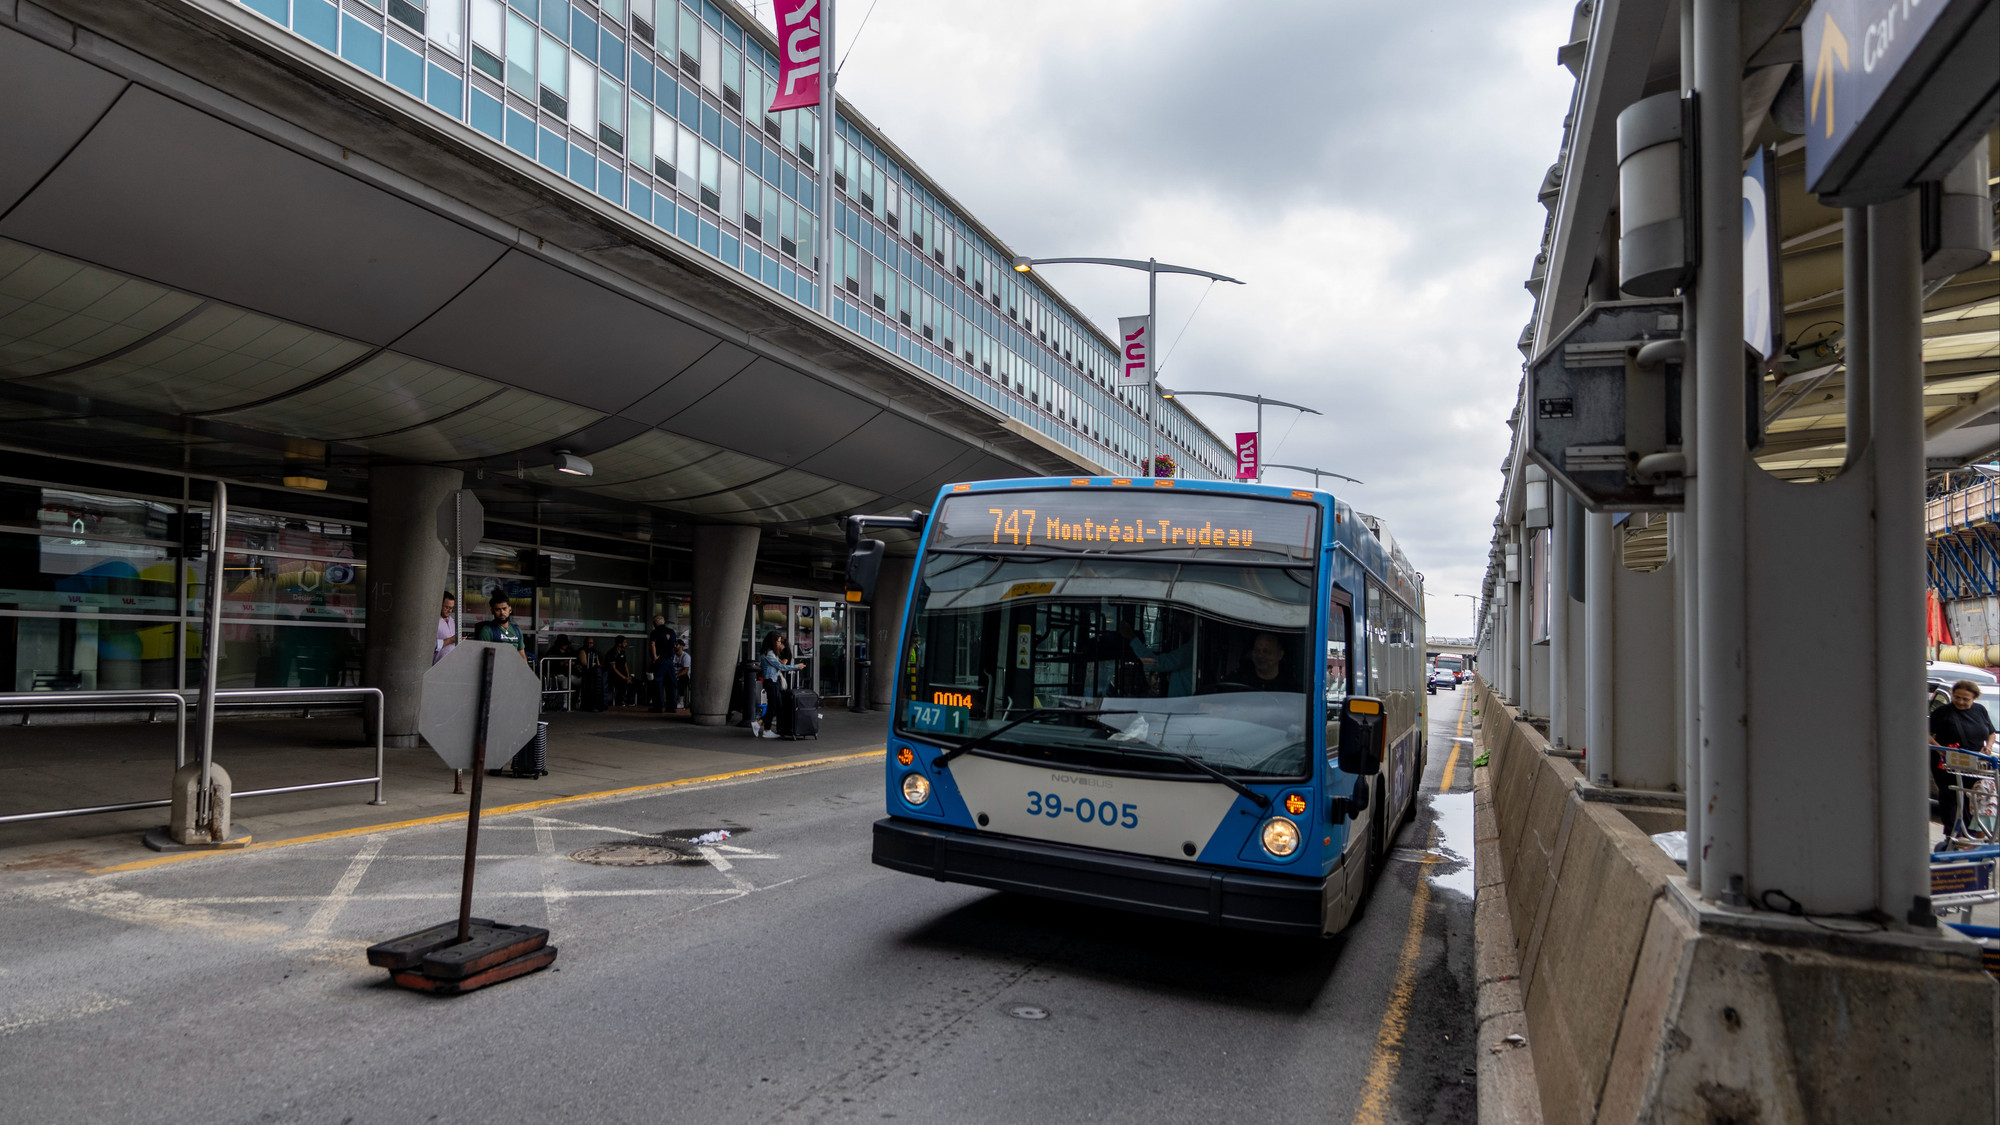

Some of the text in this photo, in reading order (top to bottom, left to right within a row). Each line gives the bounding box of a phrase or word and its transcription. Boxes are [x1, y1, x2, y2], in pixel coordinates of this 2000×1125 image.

[784, 0, 820, 96] YUL
[1863, 3, 1898, 73] Car
[1125, 326, 1145, 377] YUL
[1240, 439, 1254, 473] YUL
[989, 508, 1252, 546] 747 Montréal-Trudeau
[913, 706, 960, 729] 747 1
[1026, 791, 1139, 829] 39-005
